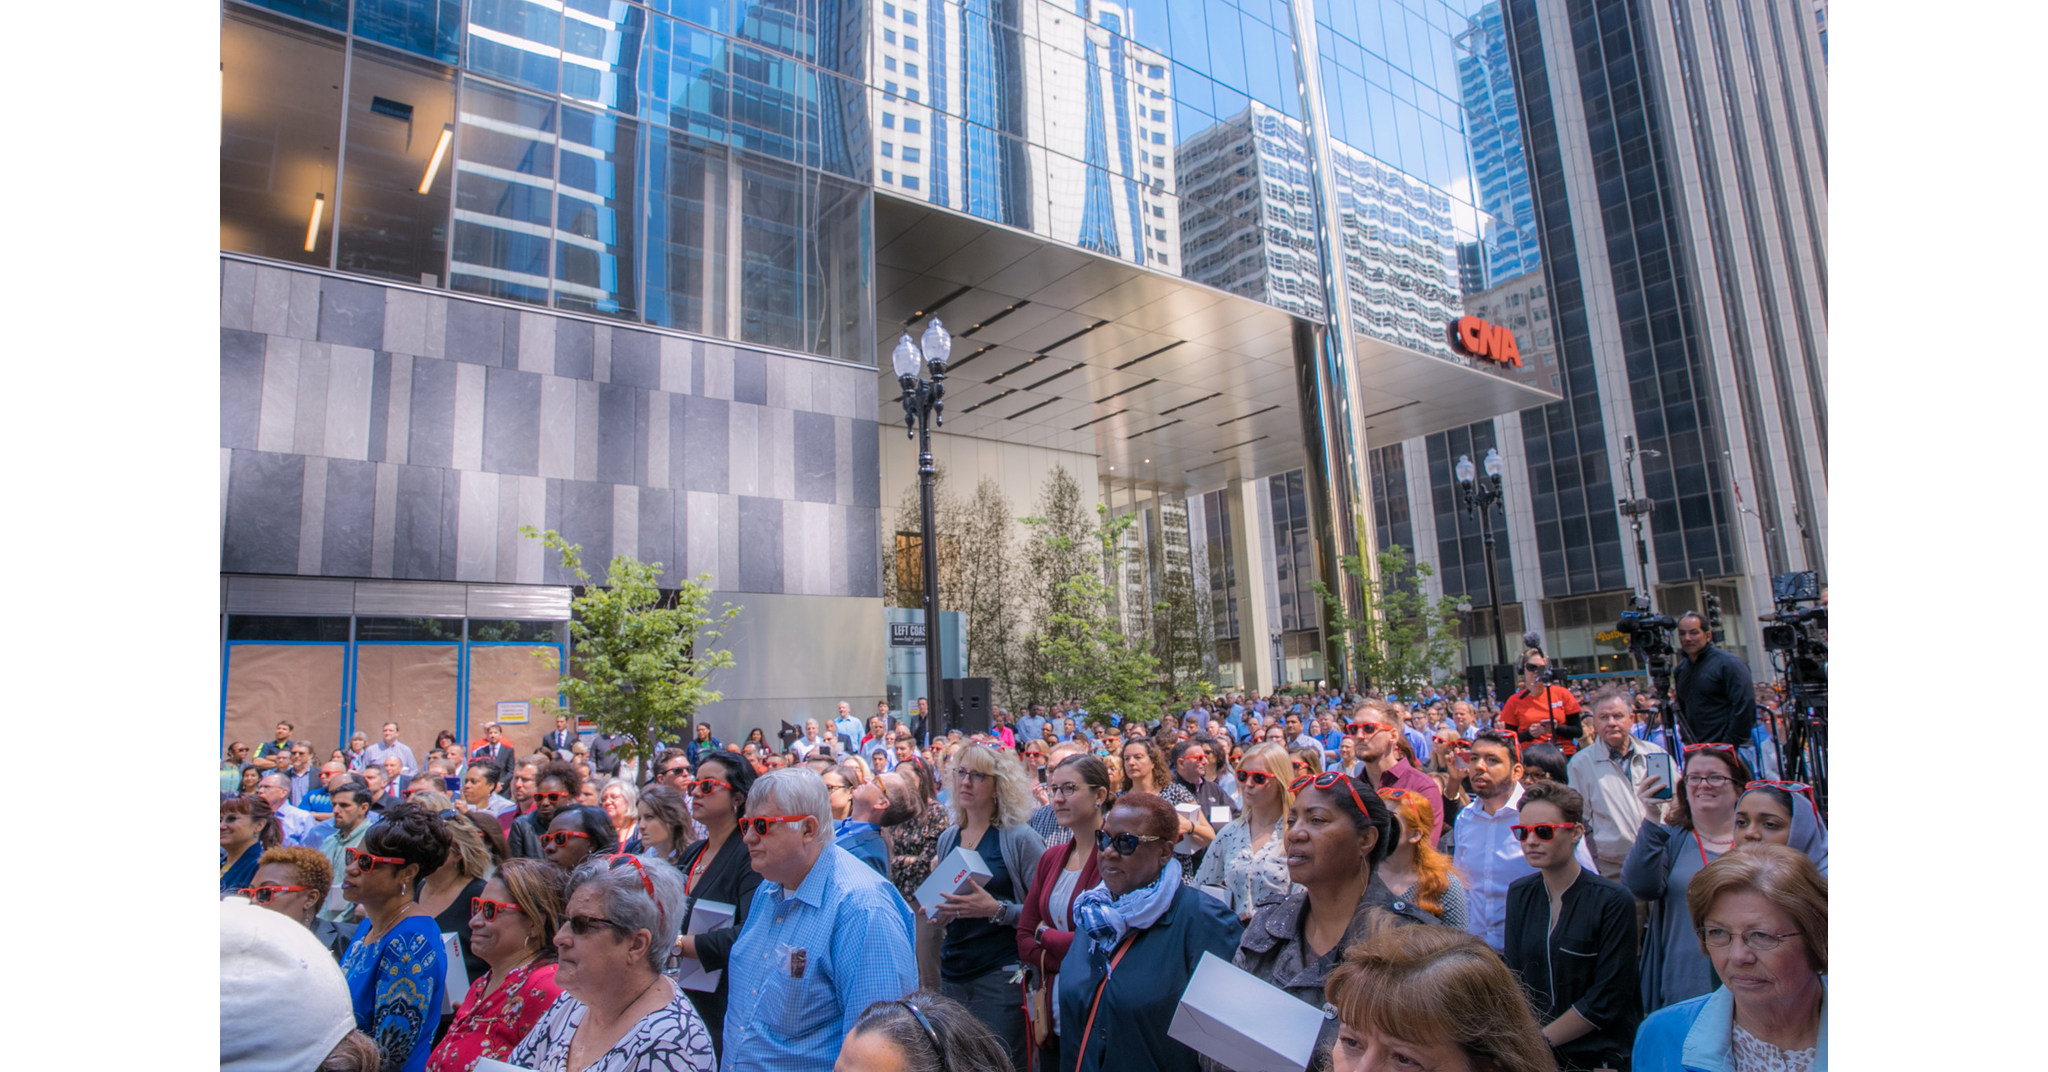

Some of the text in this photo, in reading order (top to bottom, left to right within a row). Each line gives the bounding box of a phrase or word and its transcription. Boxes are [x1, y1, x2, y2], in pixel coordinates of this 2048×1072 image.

[1458, 314, 1523, 368] CNA
[894, 625, 926, 636] LEFT COAS
[953, 869, 967, 884] CNA
